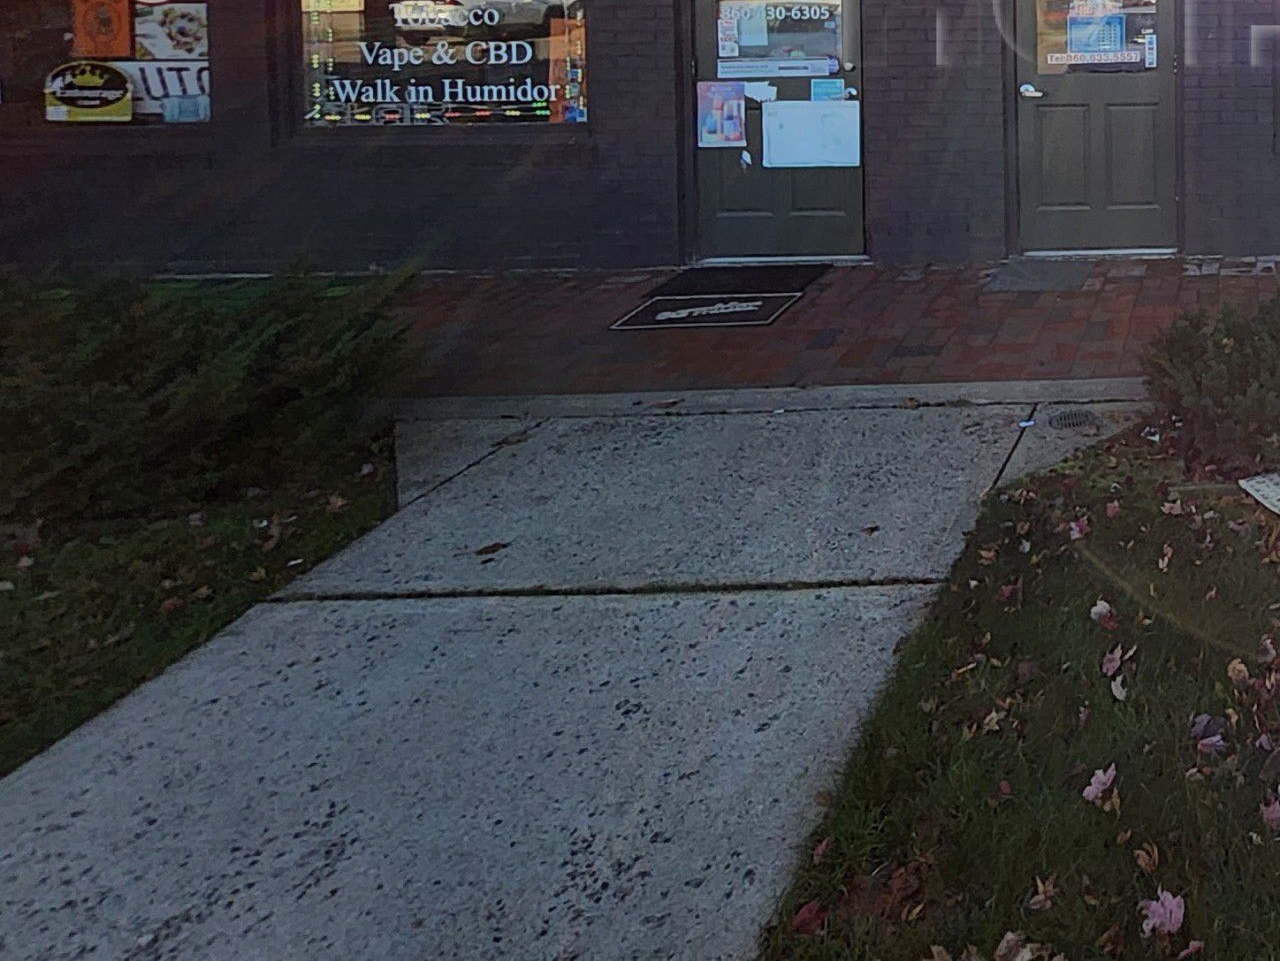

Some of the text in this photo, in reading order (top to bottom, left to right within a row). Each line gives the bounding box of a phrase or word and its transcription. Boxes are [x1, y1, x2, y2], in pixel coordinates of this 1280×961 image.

[359, 41, 533, 71] Vape & CBD
[331, 77, 562, 103] Walk in Humidor
